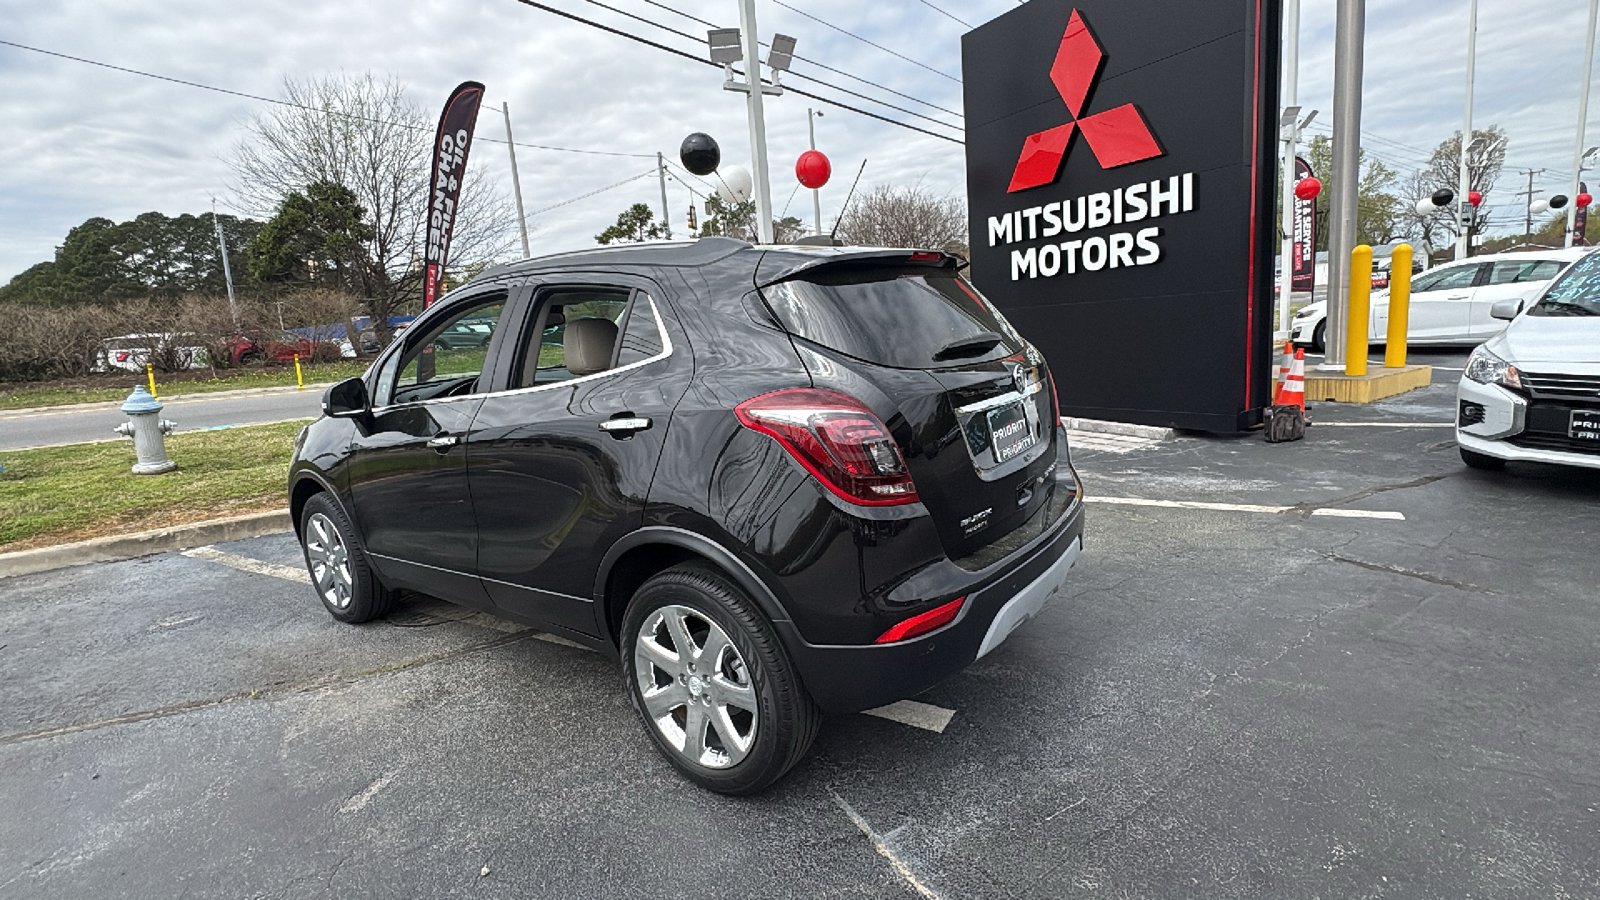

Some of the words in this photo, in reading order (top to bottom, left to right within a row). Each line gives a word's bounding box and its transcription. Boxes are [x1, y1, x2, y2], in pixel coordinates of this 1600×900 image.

[453, 129, 468, 169] OIL
[427, 134, 454, 261] CHANGES
[446, 174, 458, 192] &
[988, 172, 1193, 247] MITSUBISHI
[1293, 180, 1302, 243] GARANTEE
[436, 197, 454, 282] FILTER
[1011, 226, 1161, 281] MOTORS
[1303, 216, 1312, 261] SERVICE
[993, 418, 1026, 440] PRIORITY
[1002, 437, 1032, 459] PRIORITY
